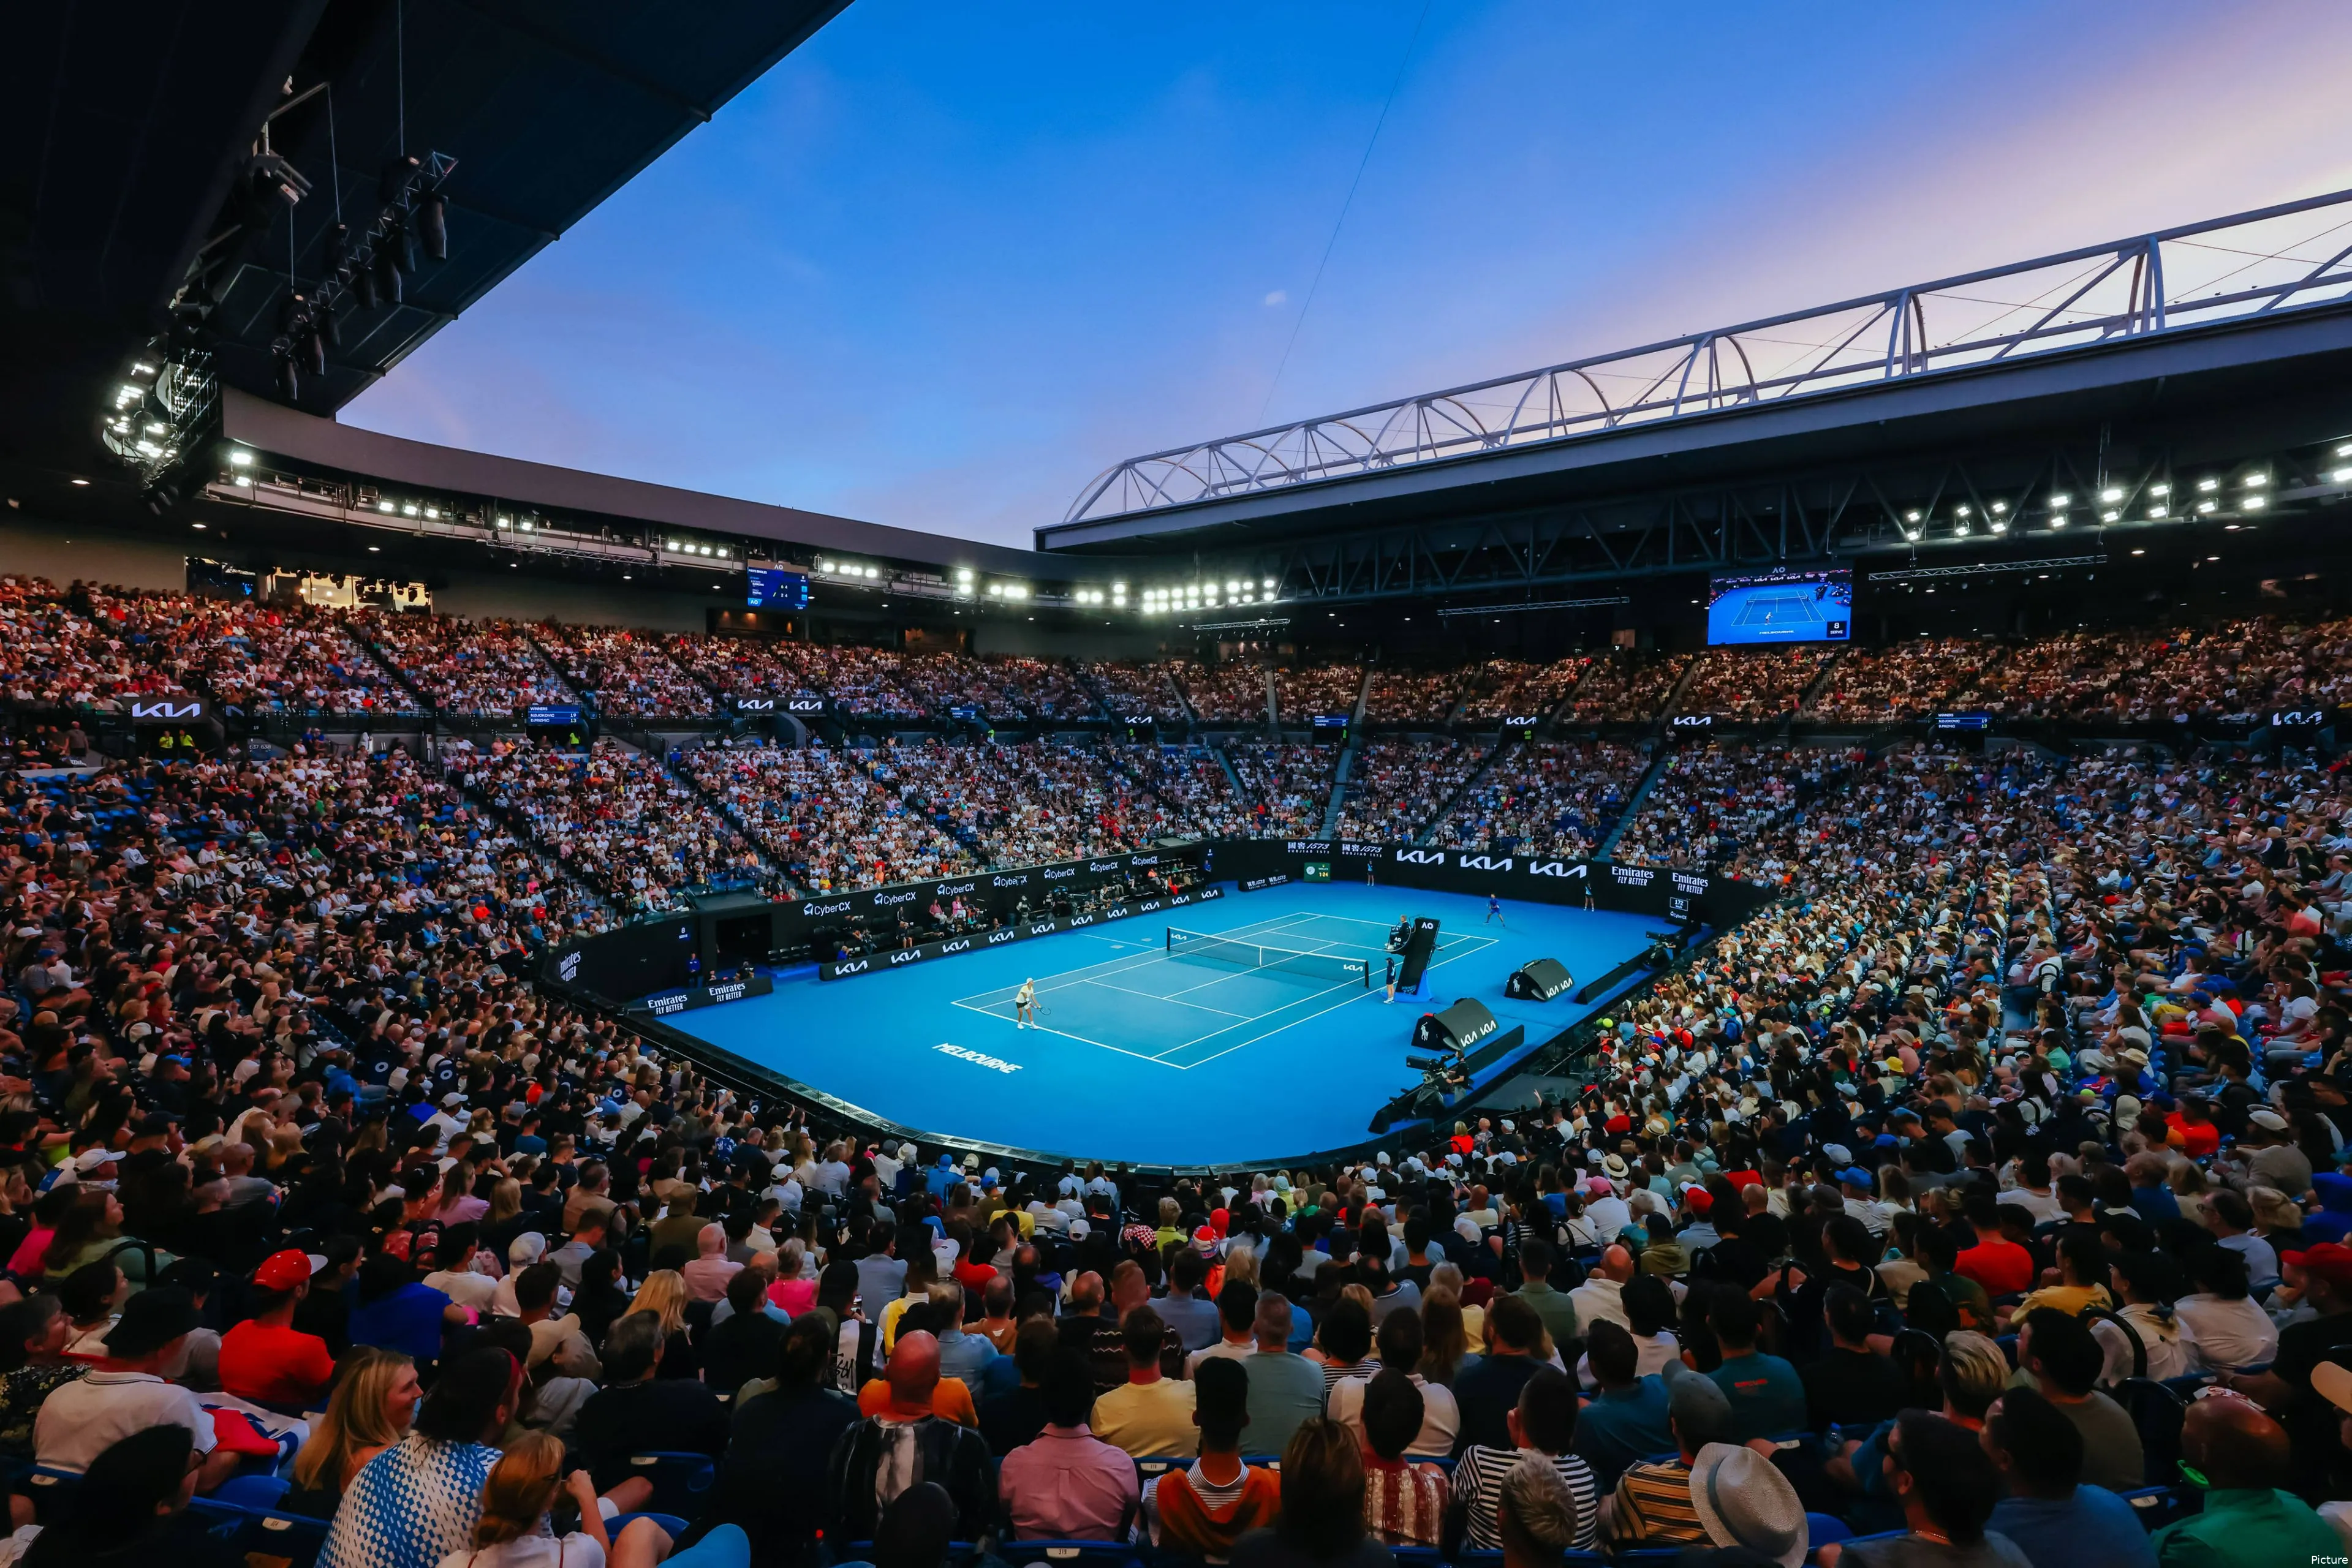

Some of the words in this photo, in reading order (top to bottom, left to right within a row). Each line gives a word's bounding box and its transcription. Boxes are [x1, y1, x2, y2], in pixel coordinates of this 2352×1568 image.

[132, 702, 200, 717] KIA
[738, 699, 773, 709] KIA
[789, 700, 822, 710] KIA
[1674, 717, 1711, 725] KIA
[1137, 856, 1158, 866] CyberCX
[1397, 849, 1444, 865] KIA
[1461, 855, 1512, 872] KIA
[1051, 868, 1075, 880] CyberCX
[1096, 862, 1118, 873] CyberCX
[1530, 861, 1587, 878] KIA
[1611, 866, 1654, 878] Emirates
[1628, 877, 1647, 886] BETTER
[1672, 872, 1708, 887] Emirates
[945, 883, 975, 896] CyberCX
[1201, 889, 1218, 899] KIA
[1686, 884, 1703, 895] BETTER
[883, 891, 917, 906] CyberCX
[1171, 895, 1190, 905] KIA
[814, 901, 850, 916] CyberCX
[1141, 901, 1160, 911] KIA
[1107, 907, 1127, 919] KIA
[1071, 914, 1093, 926] KIA
[1031, 922, 1055, 935] KIA
[988, 930, 1014, 944] KIA
[942, 940, 970, 953] KIA
[891, 949, 921, 963] KIA
[835, 960, 868, 975] KIA
[708, 982, 746, 996] Emirates
[1546, 985, 1559, 998] KIA
[1560, 978, 1573, 990] KIA
[647, 995, 687, 1008] Emirates
[725, 991, 741, 1000] BETTER
[666, 1003, 683, 1013] BETTER
[1460, 1030, 1478, 1047] KIA
[1480, 1020, 1496, 1036] KIA
[931, 1042, 1024, 1074] MELBOURNE
